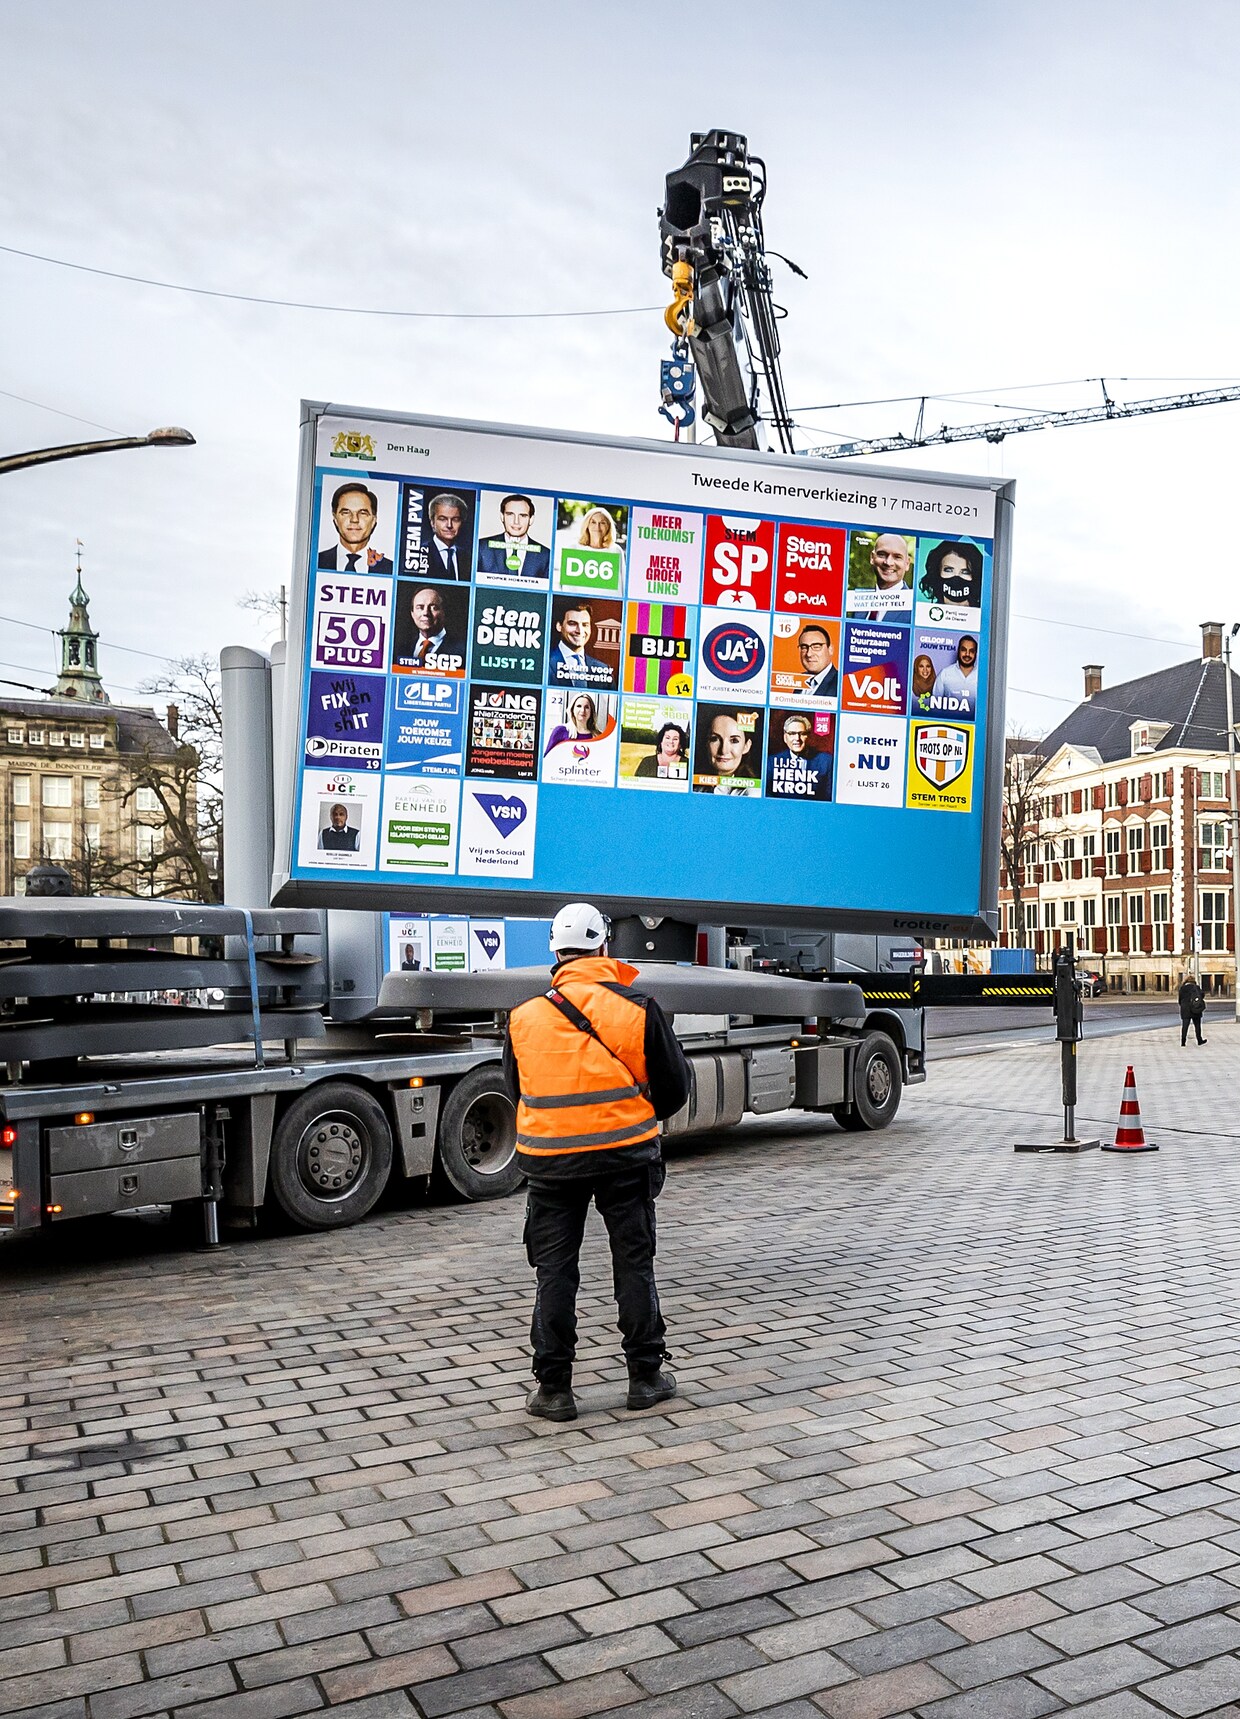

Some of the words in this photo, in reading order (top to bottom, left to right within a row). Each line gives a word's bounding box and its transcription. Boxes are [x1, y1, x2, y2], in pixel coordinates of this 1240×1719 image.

[387, 443, 405, 452] Den
[406, 445, 430, 456] Haag
[692, 473, 750, 492] Tweede
[753, 480, 877, 509] Kamerverkiezing
[881, 497, 897, 511] 17
[902, 499, 942, 513] maart
[945, 504, 978, 517] 2021
[408, 489, 423, 523] PVV
[651, 514, 682, 530] MEER
[637, 526, 695, 544] TOEKOMST
[724, 528, 756, 543] STEM
[405, 526, 421, 570] STEM
[786, 536, 832, 556] Stem
[565, 557, 614, 581] D66
[650, 555, 680, 570] MEER
[712, 541, 769, 587] SP
[786, 554, 833, 572] PvdA
[646, 568, 682, 584] GROEN
[647, 582, 679, 596] LINKS
[943, 584, 963, 597] Plan
[962, 586, 970, 597] B
[320, 585, 387, 607] STEM
[797, 592, 828, 606] PvdA
[481, 605, 541, 629] stem
[324, 616, 376, 647] 50
[780, 623, 792, 633] 16
[850, 627, 902, 640] Vernieuwend
[476, 625, 542, 649] DENK
[850, 637, 890, 647] Duurzaam
[919, 635, 945, 644] GELOOF
[641, 637, 688, 659] BIJ1
[850, 645, 887, 656] Europees
[323, 647, 373, 664] PLUS
[399, 657, 420, 666] STEM
[424, 652, 463, 672] SGP
[480, 655, 518, 670] LIJST
[520, 658, 535, 671] 12
[556, 662, 589, 673] Forum
[591, 665, 614, 675] voor
[556, 670, 613, 683] Democratie
[331, 679, 355, 693] Wij
[421, 682, 453, 702] LP
[675, 683, 690, 695] 14
[848, 673, 902, 702] Volt
[403, 699, 433, 707] LIBERTAIRE
[474, 692, 537, 711] JONG
[551, 697, 563, 705] 22
[774, 695, 832, 706] #Ombudspolitiek
[930, 695, 970, 712] NIDA
[339, 707, 358, 718] die
[474, 710, 536, 721] #NietZonderOns
[737, 713, 755, 725] NL
[412, 718, 439, 728] JOUW
[399, 726, 451, 738] TOEKOMST
[397, 735, 423, 745] JOUW
[424, 736, 452, 747] KEUZE
[847, 735, 898, 747] OPRECHT
[329, 742, 380, 756] Piraten
[471, 749, 505, 757] Jongeren
[506, 751, 534, 759] moeten
[919, 743, 941, 756] TROTS
[942, 743, 953, 756] OP
[954, 745, 963, 756] NL
[366, 760, 380, 770] 19
[470, 757, 534, 768] meebeslissen!
[773, 757, 804, 769] LIJST
[849, 754, 891, 771] .NU
[422, 766, 458, 775] STEMLP.NL
[558, 765, 602, 776] splinter
[772, 767, 819, 784] HENK
[698, 776, 718, 786] KIES
[720, 777, 756, 788] GEZOND
[772, 780, 816, 796] KROL
[857, 780, 878, 788] LIJST
[881, 781, 890, 789] 26
[911, 793, 936, 801] STEM
[938, 795, 967, 804] TROTS
[394, 802, 447, 813] EENHEID
[490, 805, 522, 820] VSN
[468, 847, 483, 858] Vrij
[496, 848, 526, 857] Sociaal
[475, 857, 519, 866] Nederland
[436, 939, 463, 947] EENHEID
[483, 938, 498, 947] VSN
